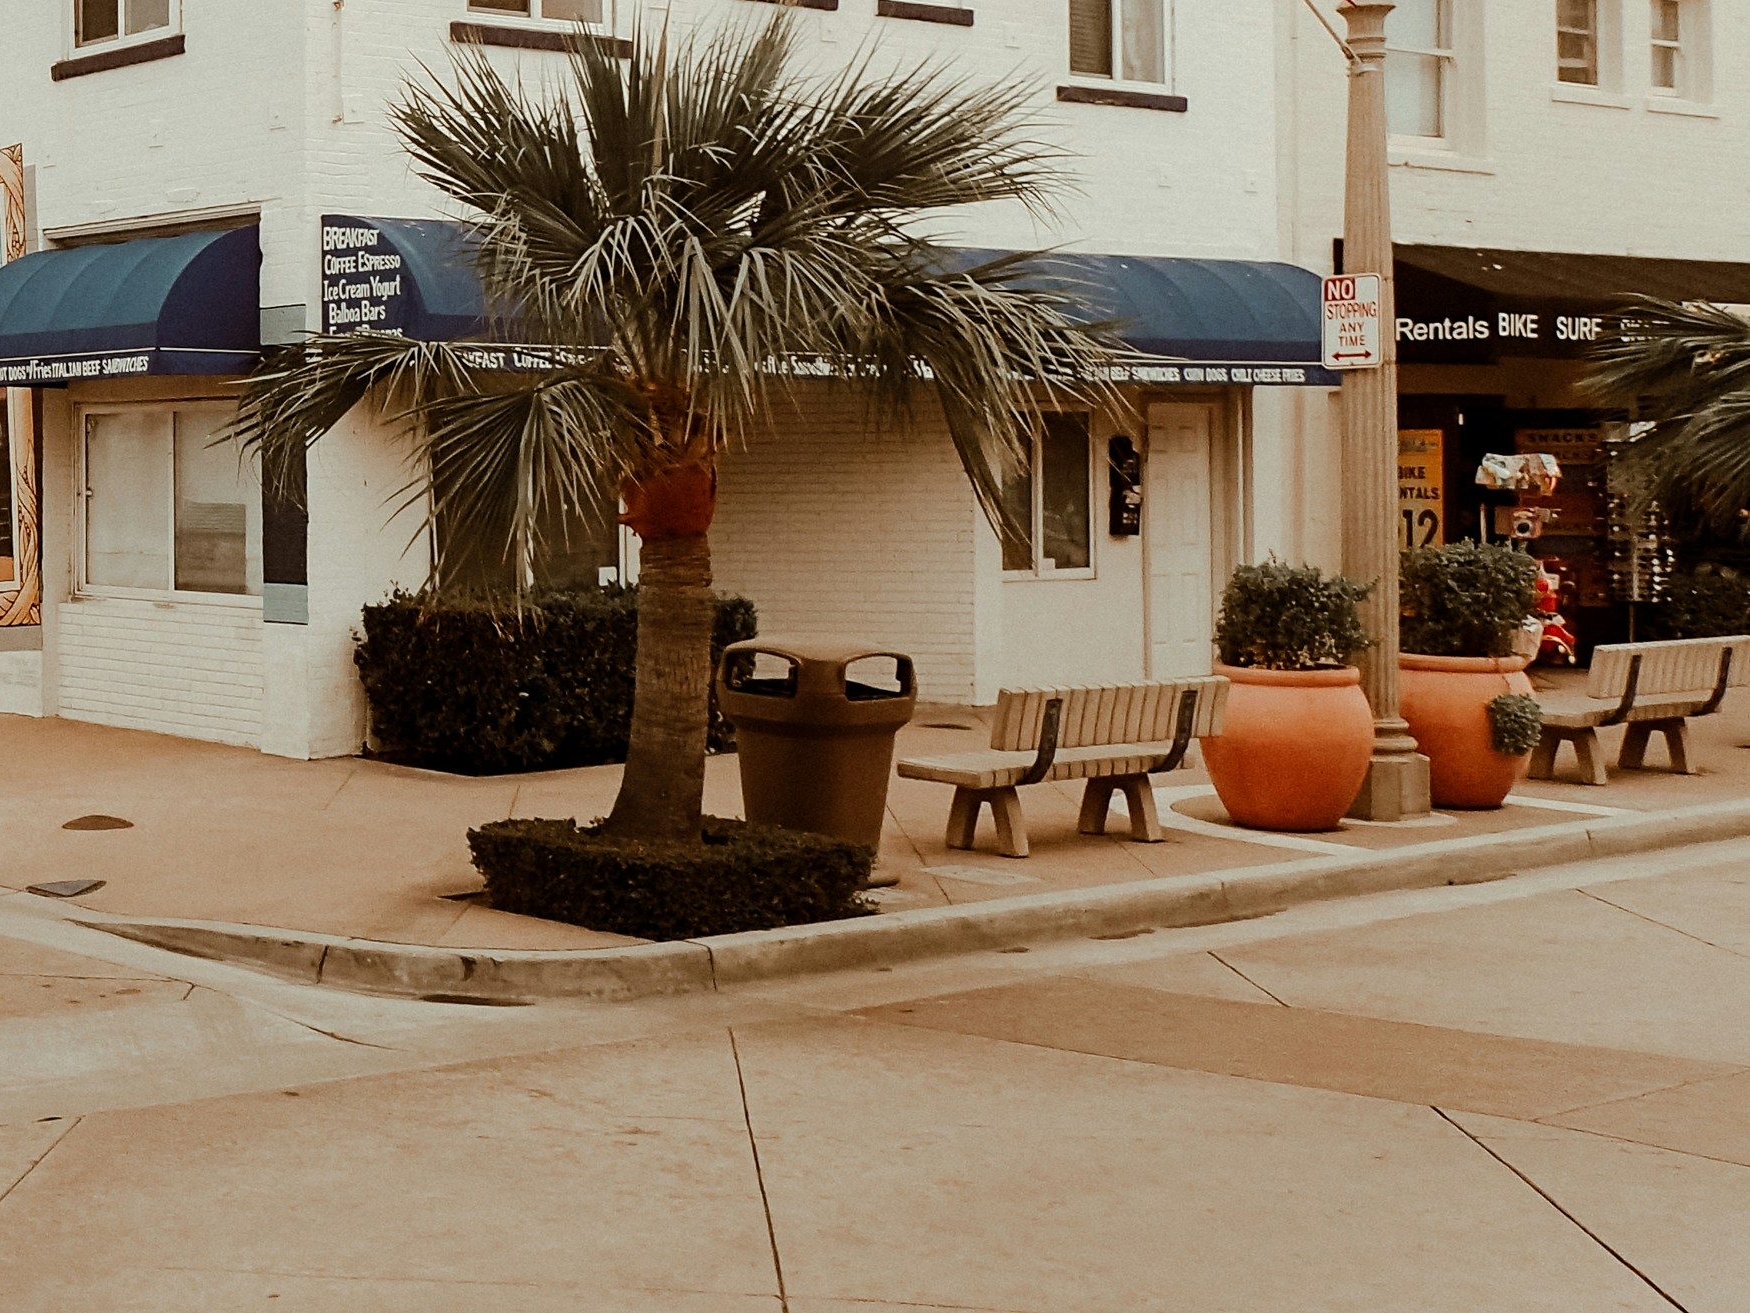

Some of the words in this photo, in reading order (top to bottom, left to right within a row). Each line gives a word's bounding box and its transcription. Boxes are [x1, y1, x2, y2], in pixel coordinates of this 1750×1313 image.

[323, 226, 380, 251] BREAKFAST
[324, 254, 357, 276] COFFEE
[357, 251, 401, 272] ESPRESSO
[323, 280, 338, 302] Ice
[338, 278, 370, 300] Cream
[370, 274, 401, 301] Yogurt
[1327, 279, 1354, 300] NO
[329, 301, 361, 324] Balboa
[361, 300, 386, 322] Bars
[1326, 301, 1377, 320] STOPPING
[1339, 322, 1365, 334] ANY
[1395, 315, 1490, 341] Rentals
[1498, 312, 1539, 339] BIKE
[1556, 316, 1603, 341] SURF
[1338, 335, 1366, 347] TIME
[8, 365, 26, 381] DOGS
[51, 361, 82, 378] ITALIAN
[82, 359, 100, 377] BEEF
[102, 355, 149, 374] SANDWICHES
[1399, 486, 1440, 500] NTALS
